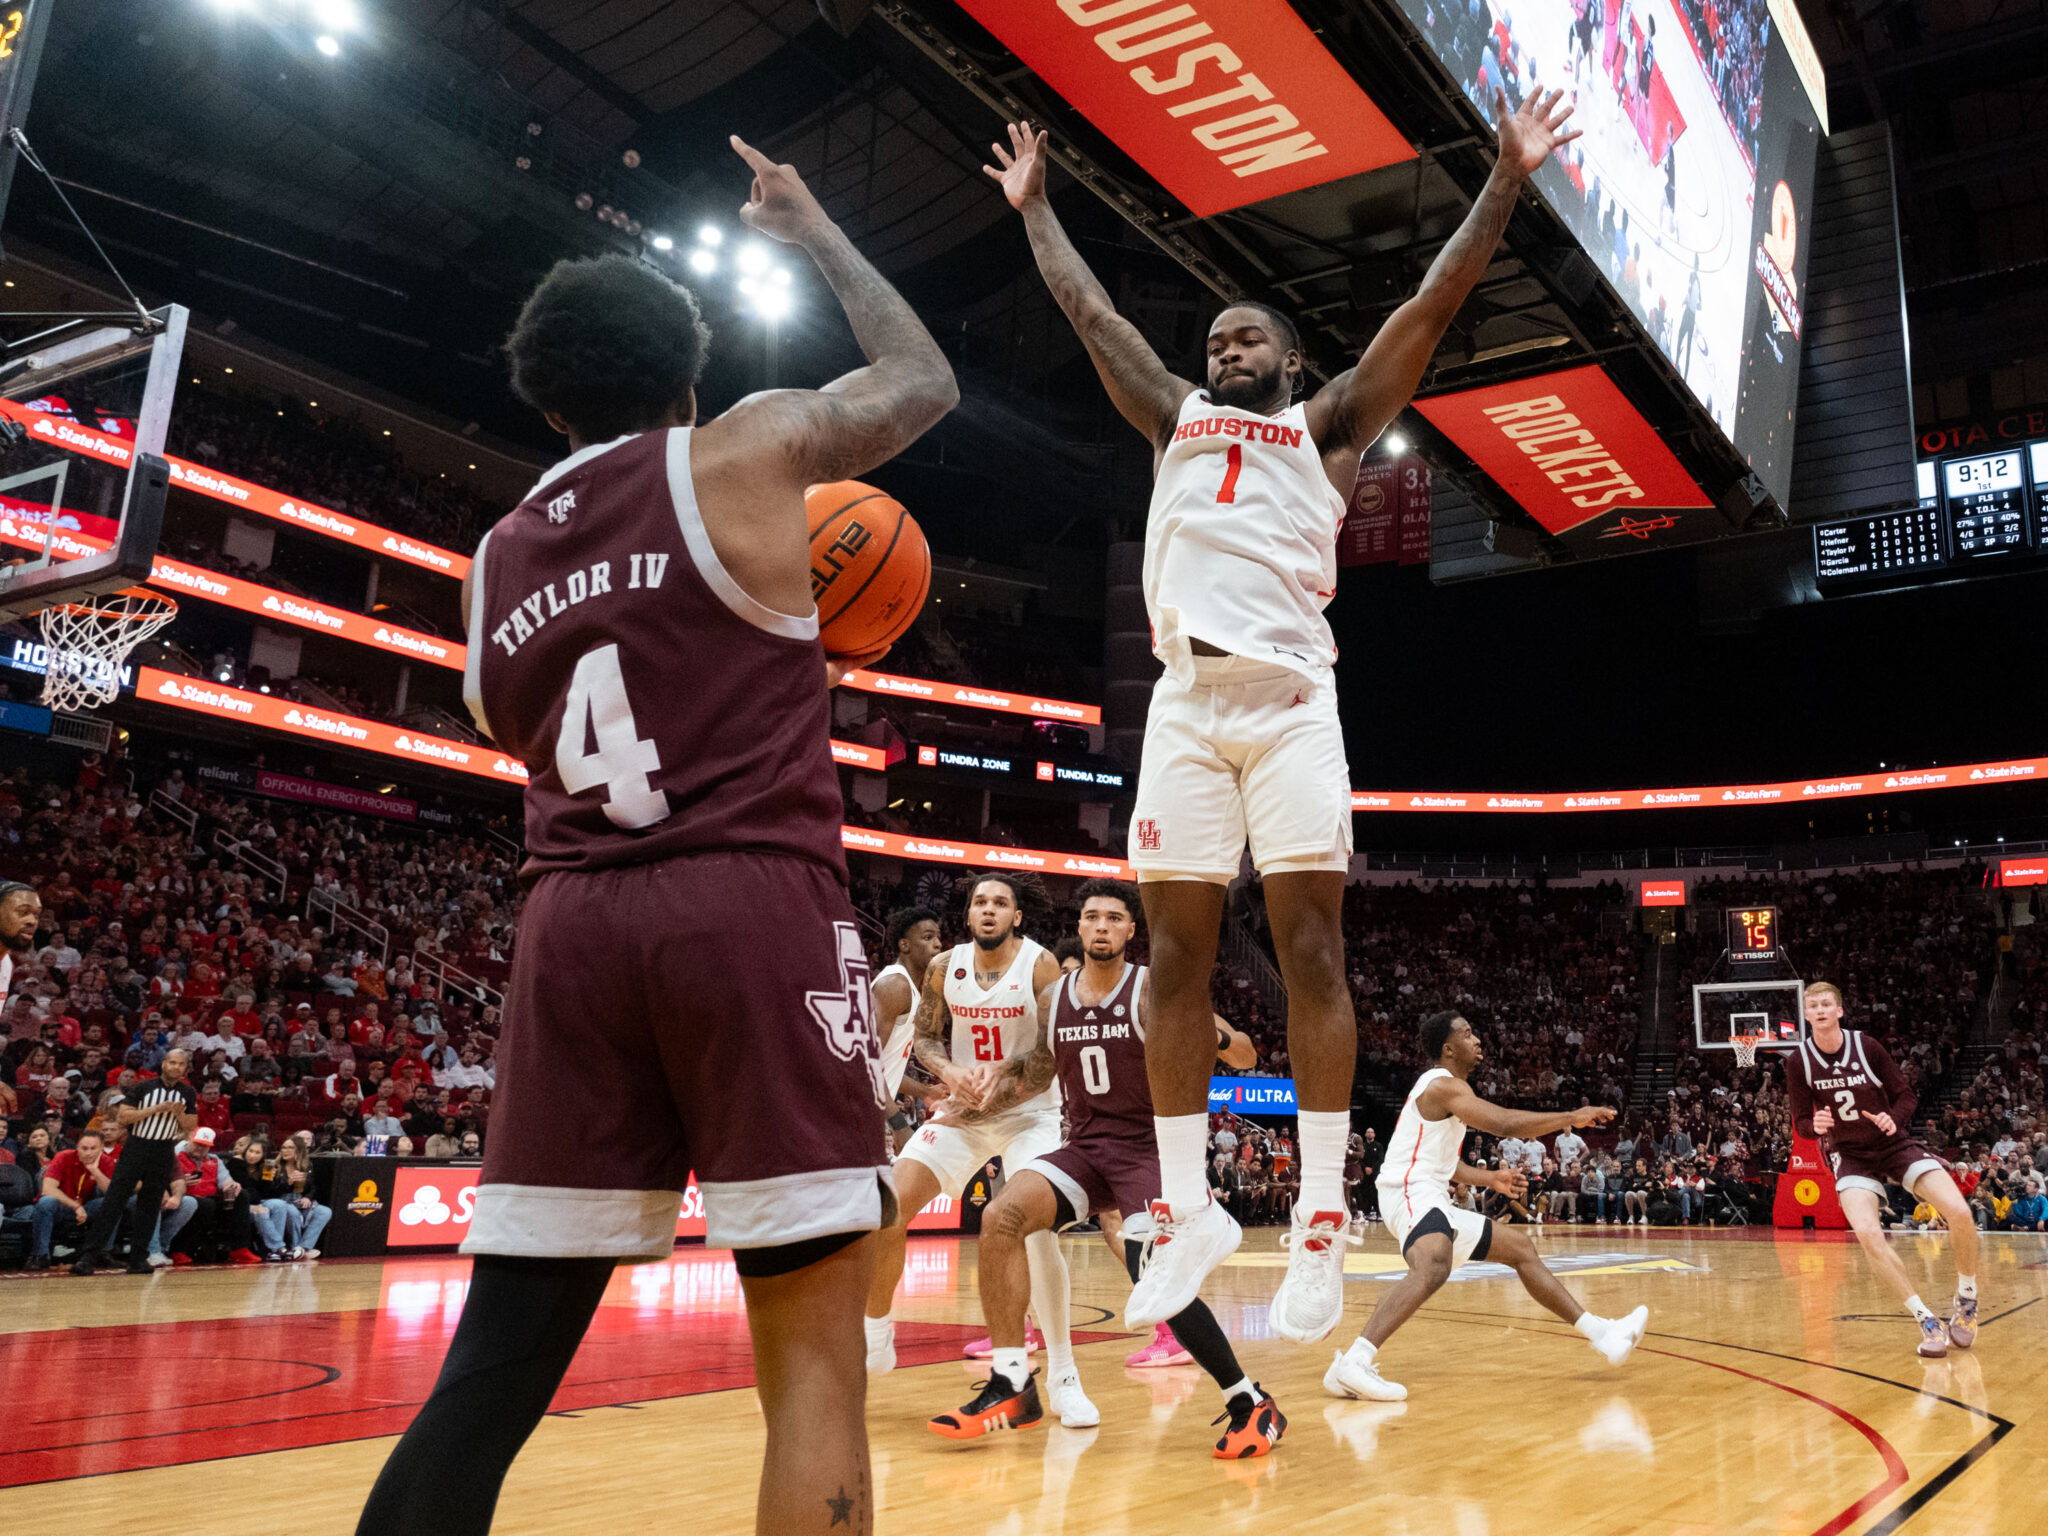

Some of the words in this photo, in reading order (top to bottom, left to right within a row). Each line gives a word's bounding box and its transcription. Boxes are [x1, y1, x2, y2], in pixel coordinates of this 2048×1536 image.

[1056, 0, 1329, 178] OUSTON
[1755, 245, 1800, 333] SHOWCASE
[1174, 418, 1303, 448] HOUSTON
[1915, 424, 1989, 452] OTA
[1482, 395, 1645, 508] ROCKETS
[1216, 443, 1242, 504] 1
[1958, 459, 2008, 482] 9:12
[1977, 482, 1992, 490] 1st
[1978, 494, 1994, 502] FLS
[491, 560, 612, 656] TAYLOR
[628, 553, 669, 589] IV
[555, 643, 671, 829] 4
[939, 753, 979, 767] TUNDRA
[982, 759, 1010, 771] ZONE
[199, 765, 239, 783] reliant
[1056, 768, 1094, 782] TUNDRA
[1096, 774, 1122, 786] ZONE
[262, 777, 314, 796] OFFICIAL
[316, 788, 360, 807] ENERGY
[362, 796, 413, 815] PROVIDER
[419, 808, 452, 824] reliant
[1742, 911, 1770, 926] 9:12
[1747, 925, 1768, 948] 15
[1744, 951, 1775, 960] TISSOT
[951, 1004, 1025, 1019] HOUSTON
[971, 1025, 1004, 1061] 21
[1058, 1025, 1098, 1042] TEXAS
[1102, 1023, 1130, 1039] A&M
[1079, 1045, 1111, 1095] 0
[1814, 1077, 1845, 1090] TEXAS
[1245, 1088, 1294, 1103] ULTRA
[1834, 1090, 1860, 1121] 2
